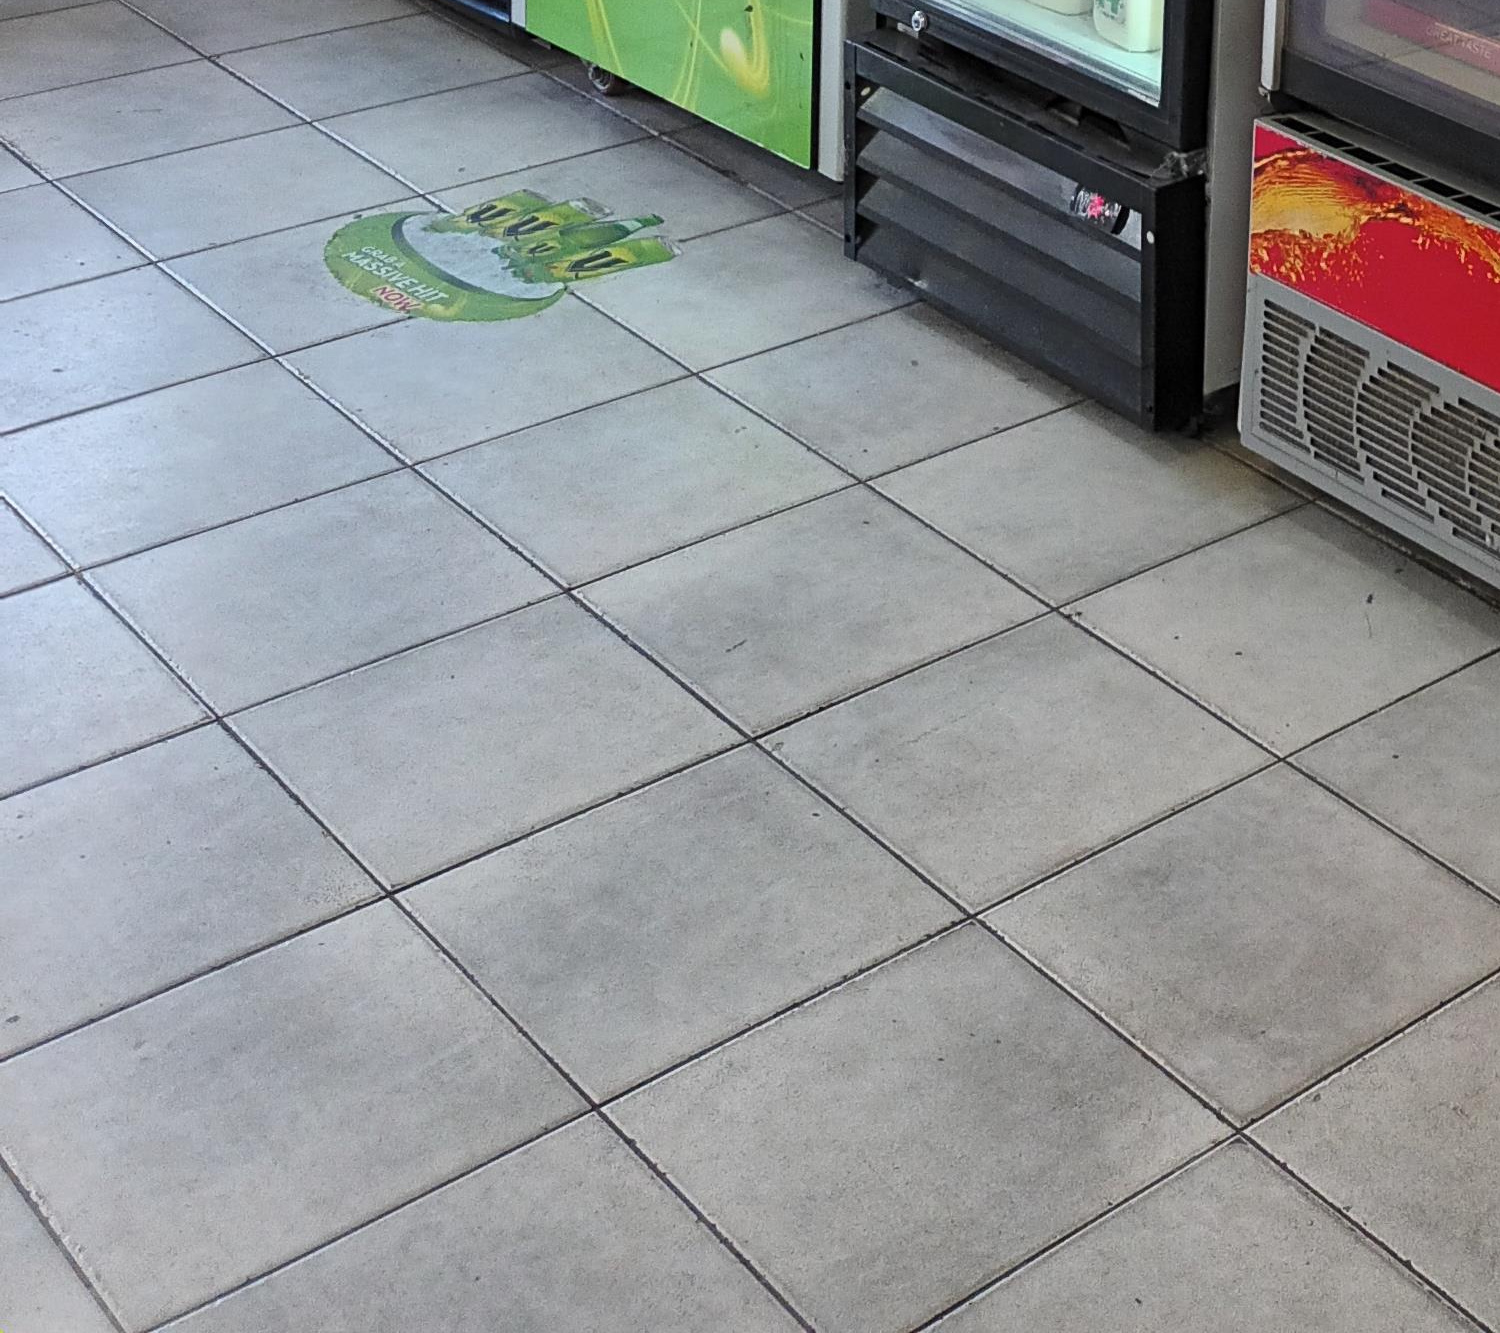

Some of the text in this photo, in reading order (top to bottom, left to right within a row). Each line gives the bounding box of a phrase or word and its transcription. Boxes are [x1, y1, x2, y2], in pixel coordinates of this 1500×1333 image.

[341, 251, 450, 302] MASSIVE HIT
[373, 285, 423, 312] NOW
